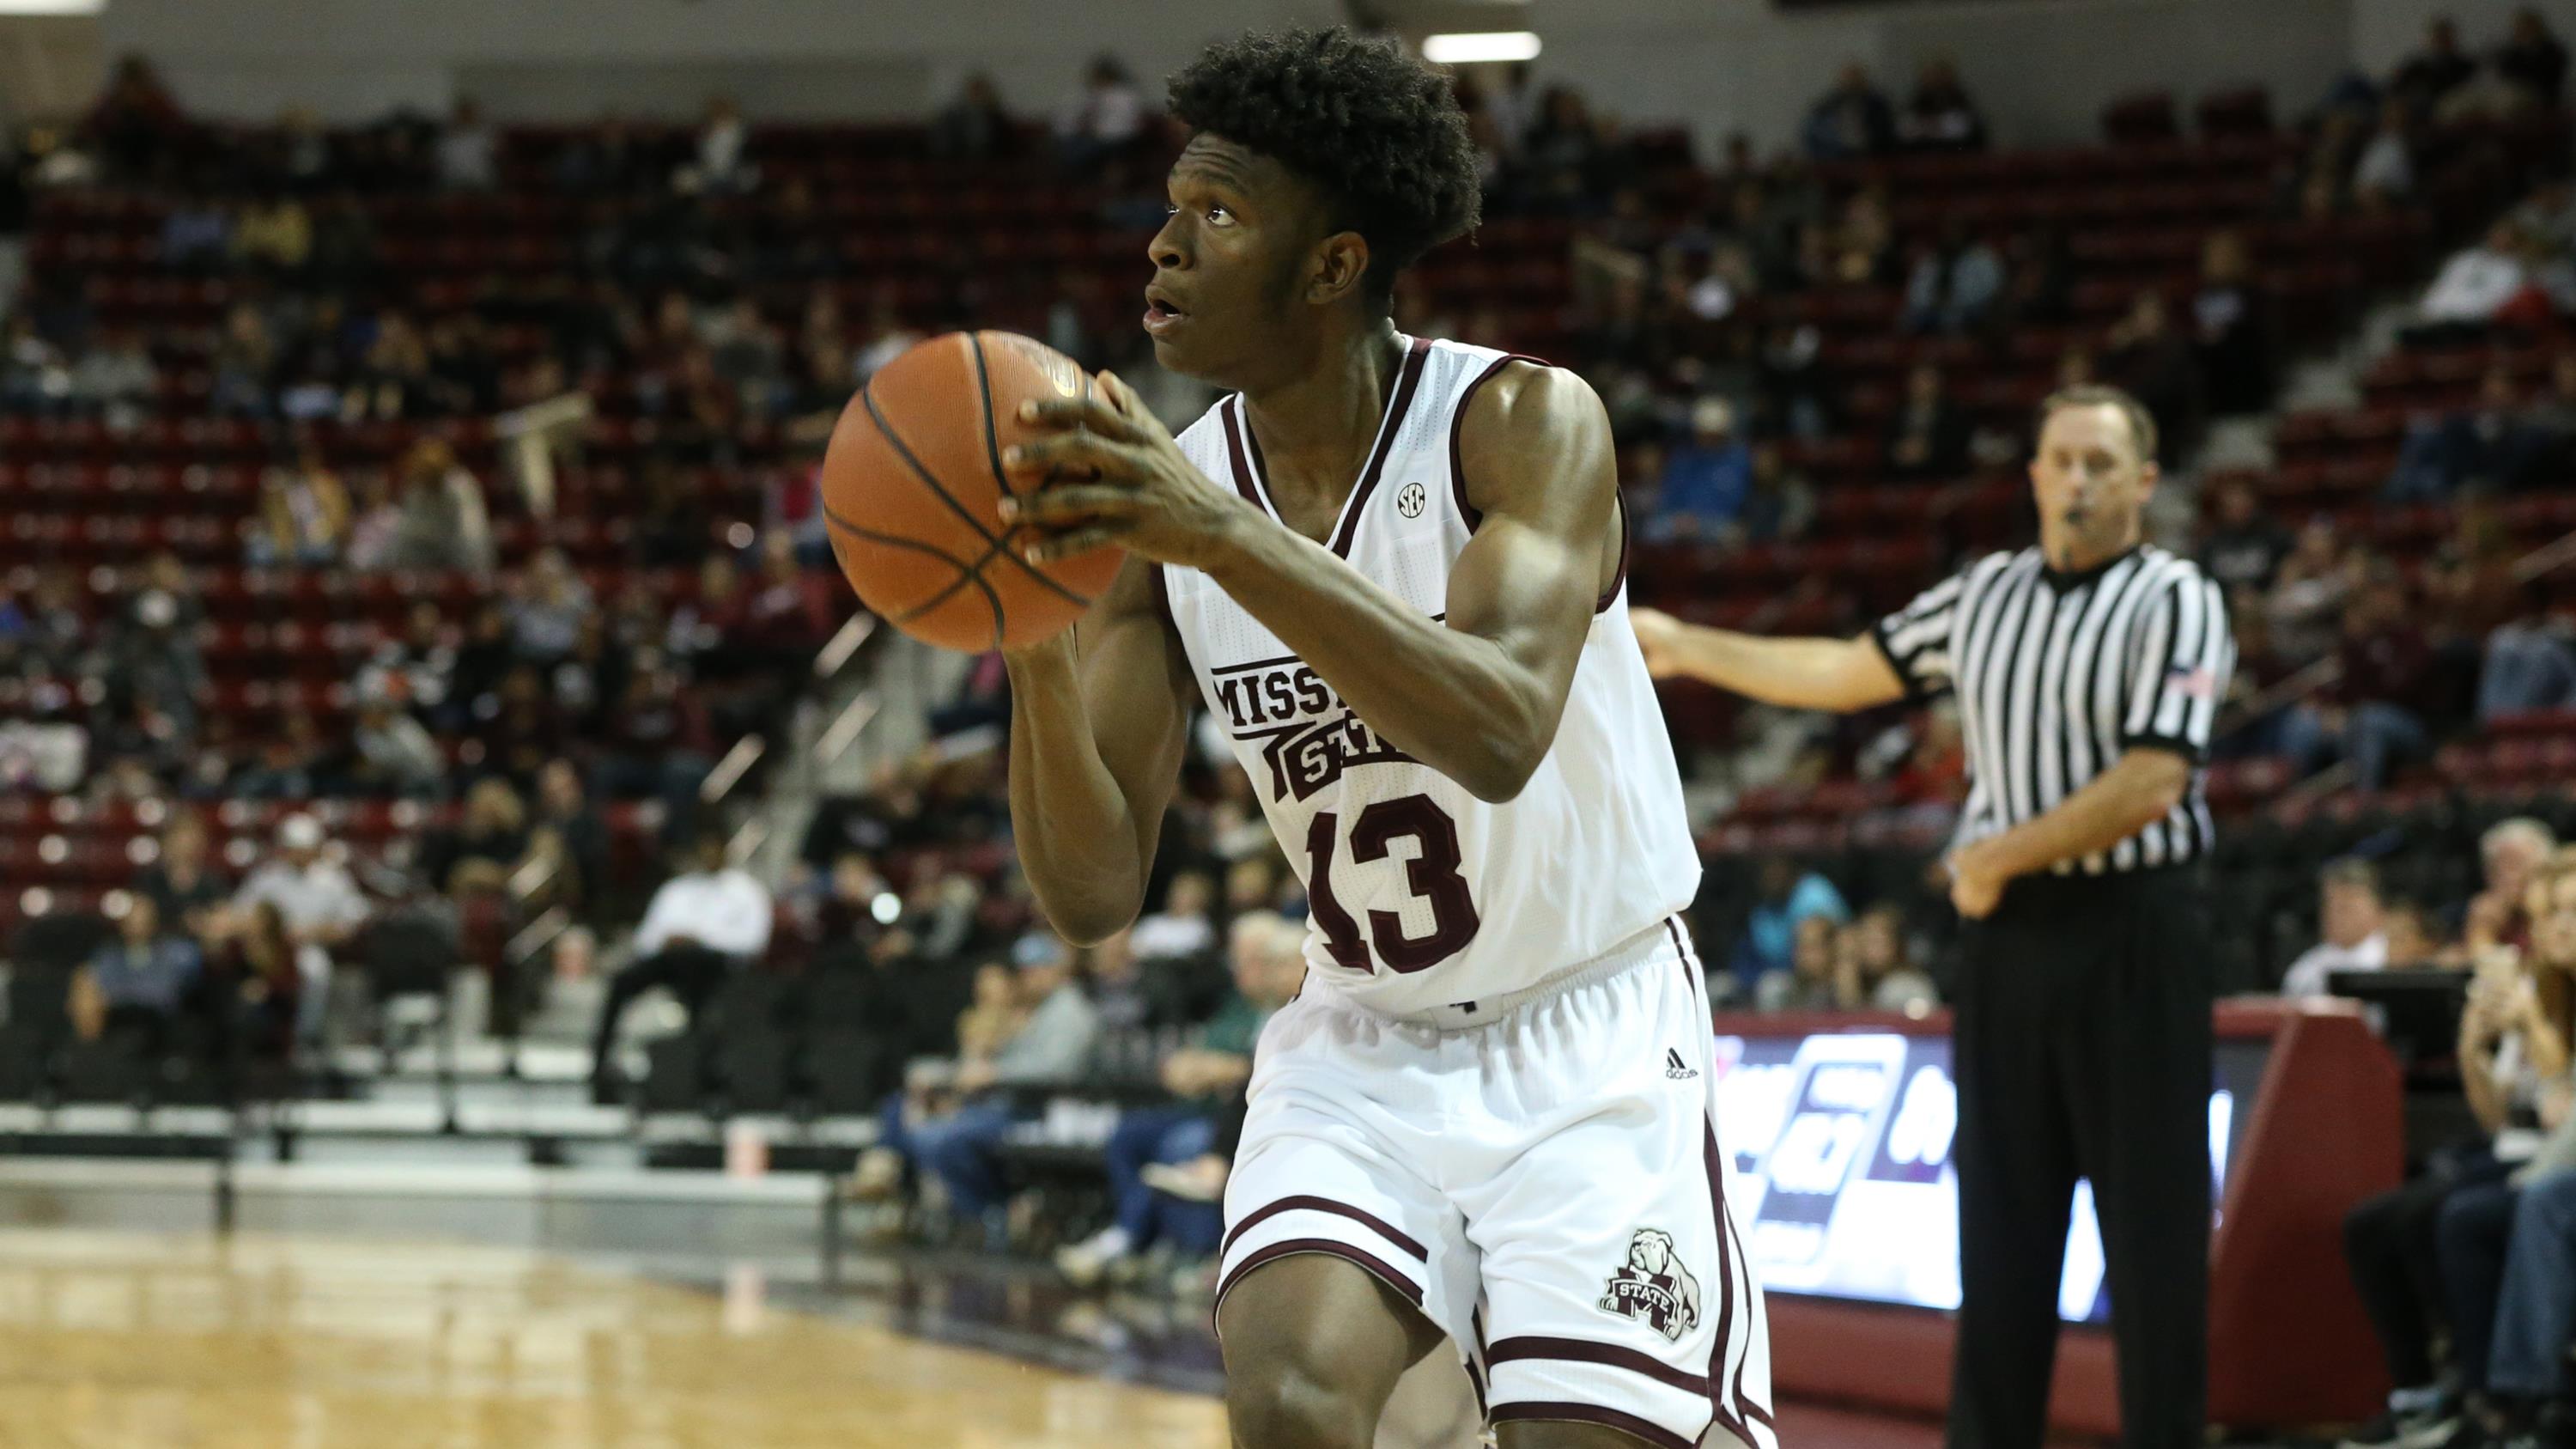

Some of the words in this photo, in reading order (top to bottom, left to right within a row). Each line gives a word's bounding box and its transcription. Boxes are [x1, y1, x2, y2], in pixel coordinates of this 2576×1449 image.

[1398, 483, 1425, 518] SEC
[1213, 667, 1346, 727] MISS
[1306, 794, 1479, 976] 13
[1619, 1284, 1669, 1312] STATE
